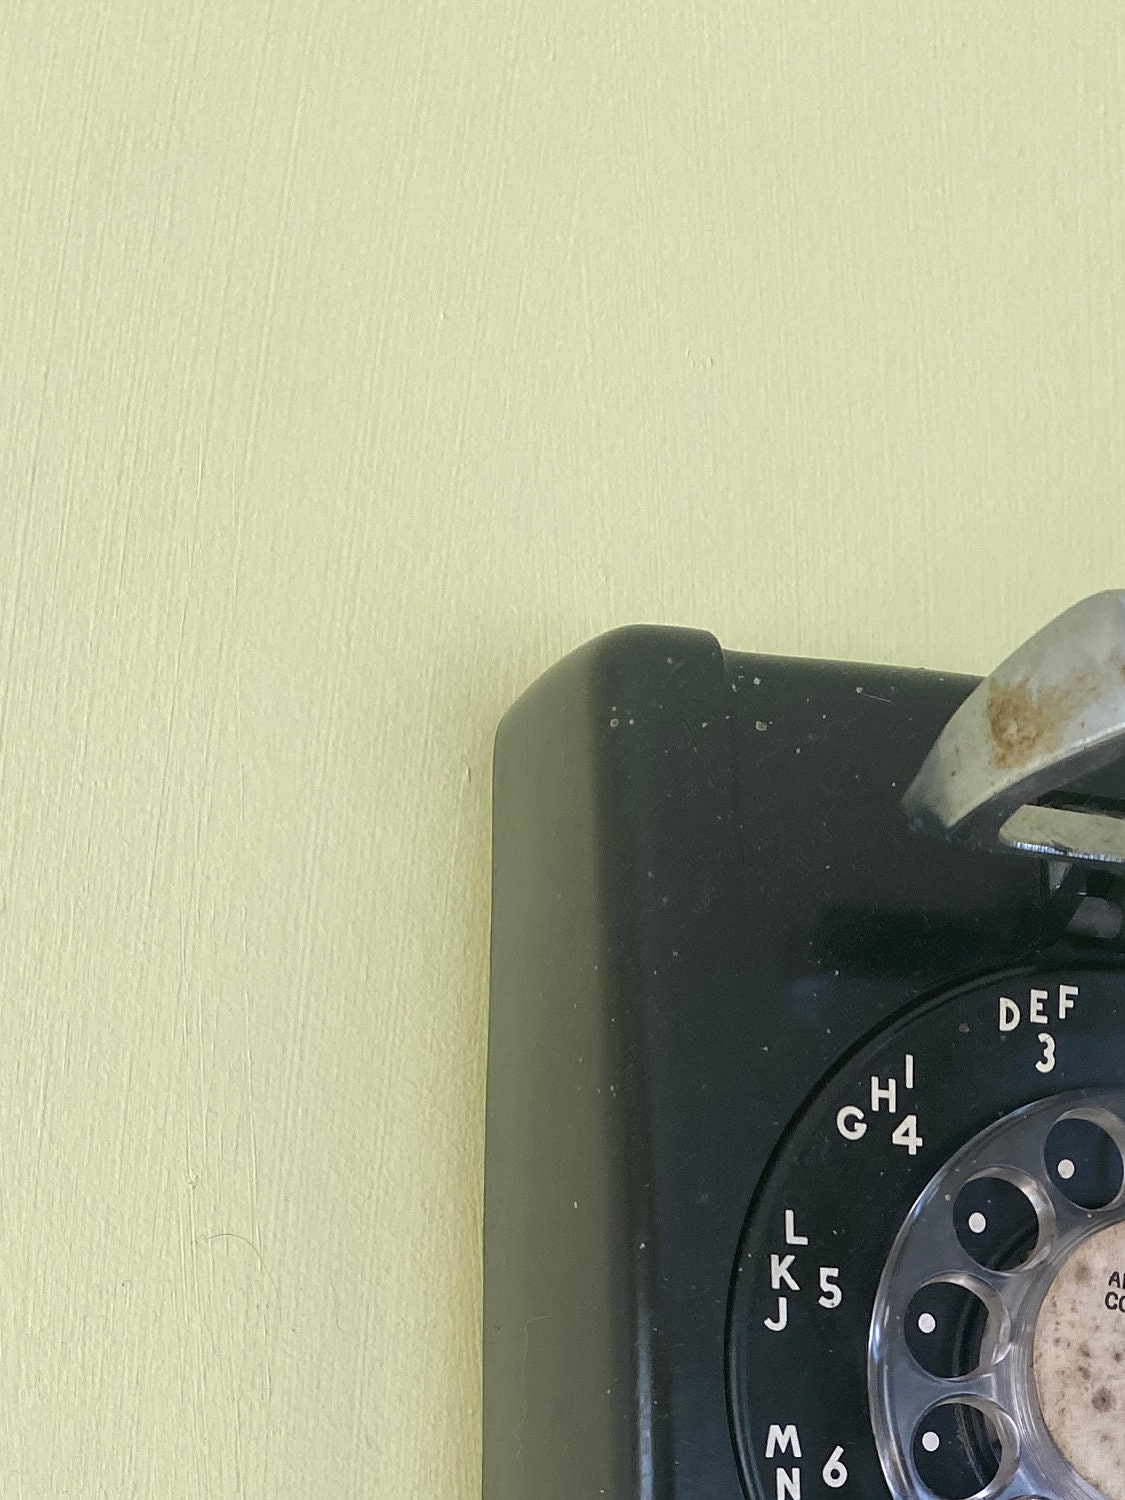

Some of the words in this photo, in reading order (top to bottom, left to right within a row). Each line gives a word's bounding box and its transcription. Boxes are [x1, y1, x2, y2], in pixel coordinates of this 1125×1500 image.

[999, 984, 1079, 1031] DEF
[1035, 1032, 1056, 1073] 3
[836, 1054, 914, 1141] GHI
[891, 1114, 923, 1156] 4
[818, 1267, 842, 1309] 5
[822, 1445, 848, 1488] 6
